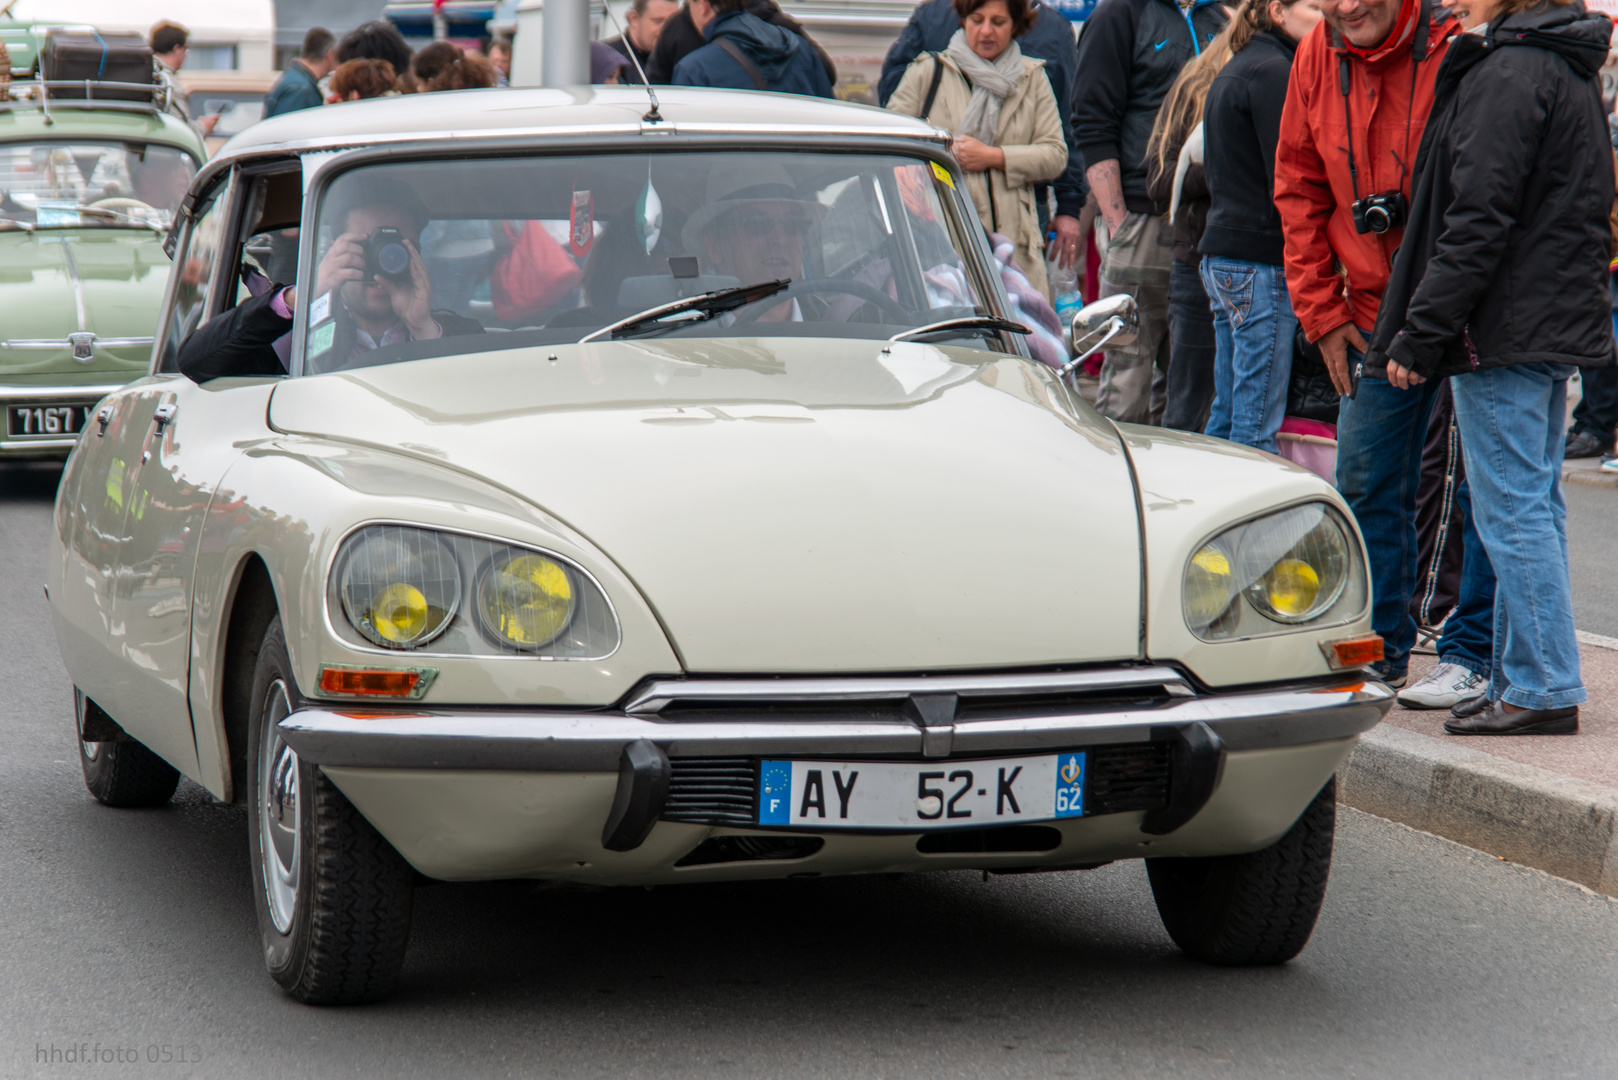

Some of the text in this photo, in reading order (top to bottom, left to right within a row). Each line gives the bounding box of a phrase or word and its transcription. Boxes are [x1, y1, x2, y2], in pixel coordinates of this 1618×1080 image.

[17, 407, 73, 433] 7167
[769, 799, 780, 813] F
[799, 769, 859, 819] AY
[1056, 787, 1081, 812] 62
